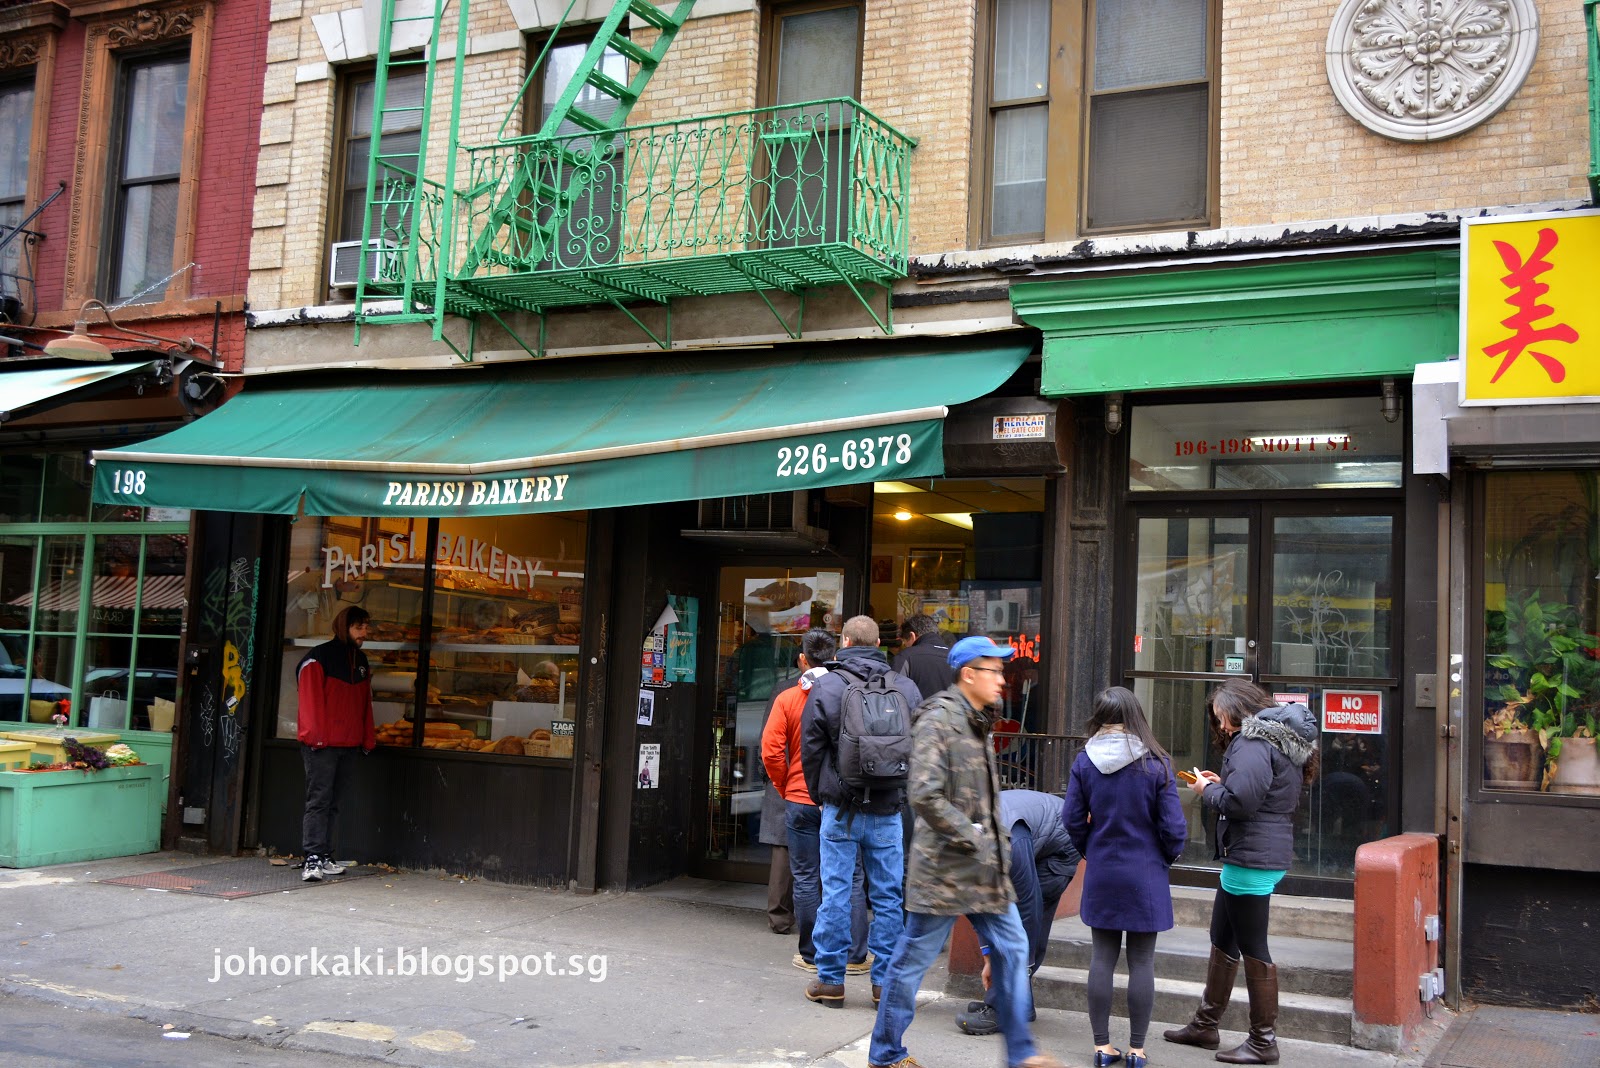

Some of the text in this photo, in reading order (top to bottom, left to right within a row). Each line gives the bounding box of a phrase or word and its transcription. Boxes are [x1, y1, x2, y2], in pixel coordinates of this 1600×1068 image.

[1481, 227, 1580, 385] 美
[994, 416, 1044, 427] AMERICAN
[776, 433, 912, 477] 226-6378
[1174, 435, 1358, 457] 196-198 MOTT ST.
[113, 469, 147, 495] 198
[382, 474, 570, 507] PARISI BAKERY
[320, 530, 416, 589] PARISI
[436, 531, 542, 592] BAKERY
[1227, 661, 1242, 671] PUSH
[1274, 694, 1307, 702] WARNING
[1341, 696, 1363, 711] NO
[552, 722, 575, 732] ZAGA
[1326, 711, 1378, 726] TRESPASSING
